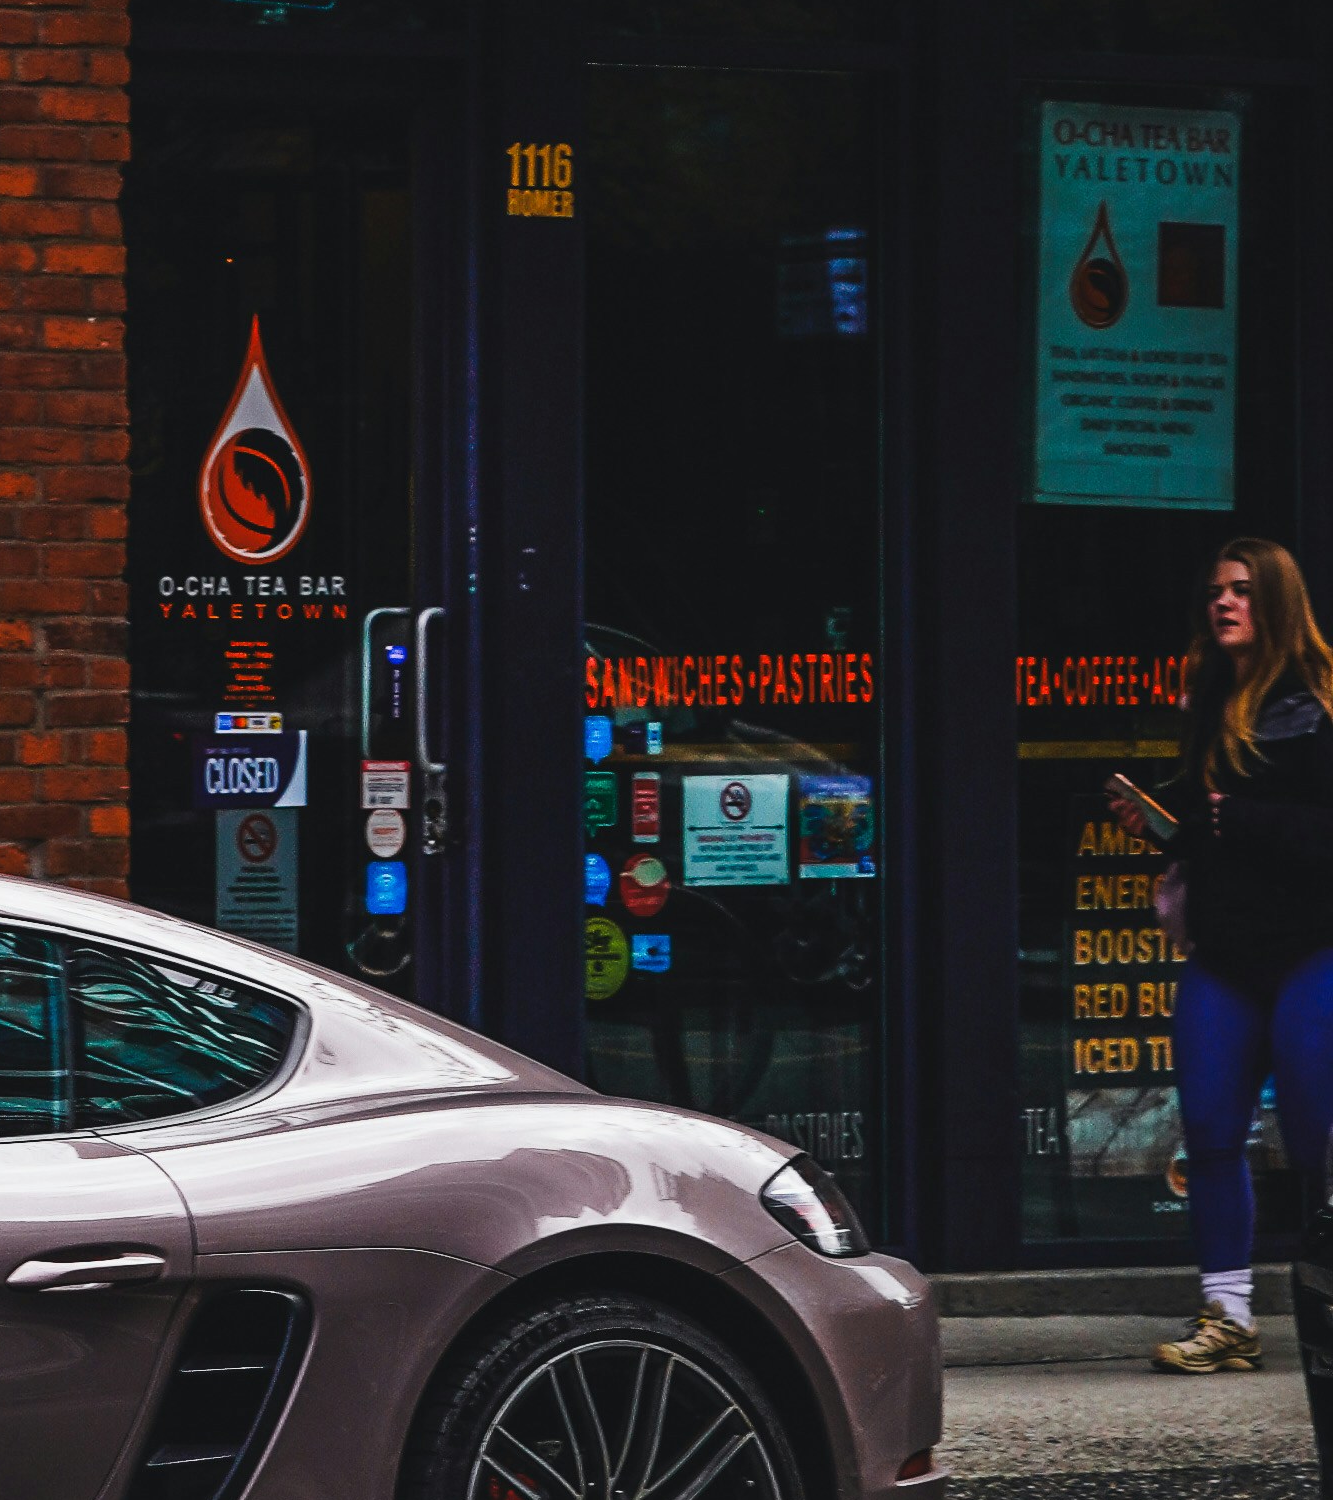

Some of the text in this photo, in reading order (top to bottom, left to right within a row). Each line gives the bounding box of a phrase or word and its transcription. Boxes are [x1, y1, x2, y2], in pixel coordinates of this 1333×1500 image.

[1139, 123, 1182, 151] TEA
[506, 142, 573, 188] 1116
[1054, 154, 1233, 188] YALETOWN
[159, 575, 347, 596] O-CHA TEA BAR
[159, 602, 348, 620] YALETOWN
[585, 653, 874, 708] SANDWICHES PASTRIES
[1063, 655, 1140, 706] COFFEE
[205, 757, 280, 794] CLOSED
[1074, 983, 1130, 1019] RED
[1073, 1038, 1139, 1074] ICED
